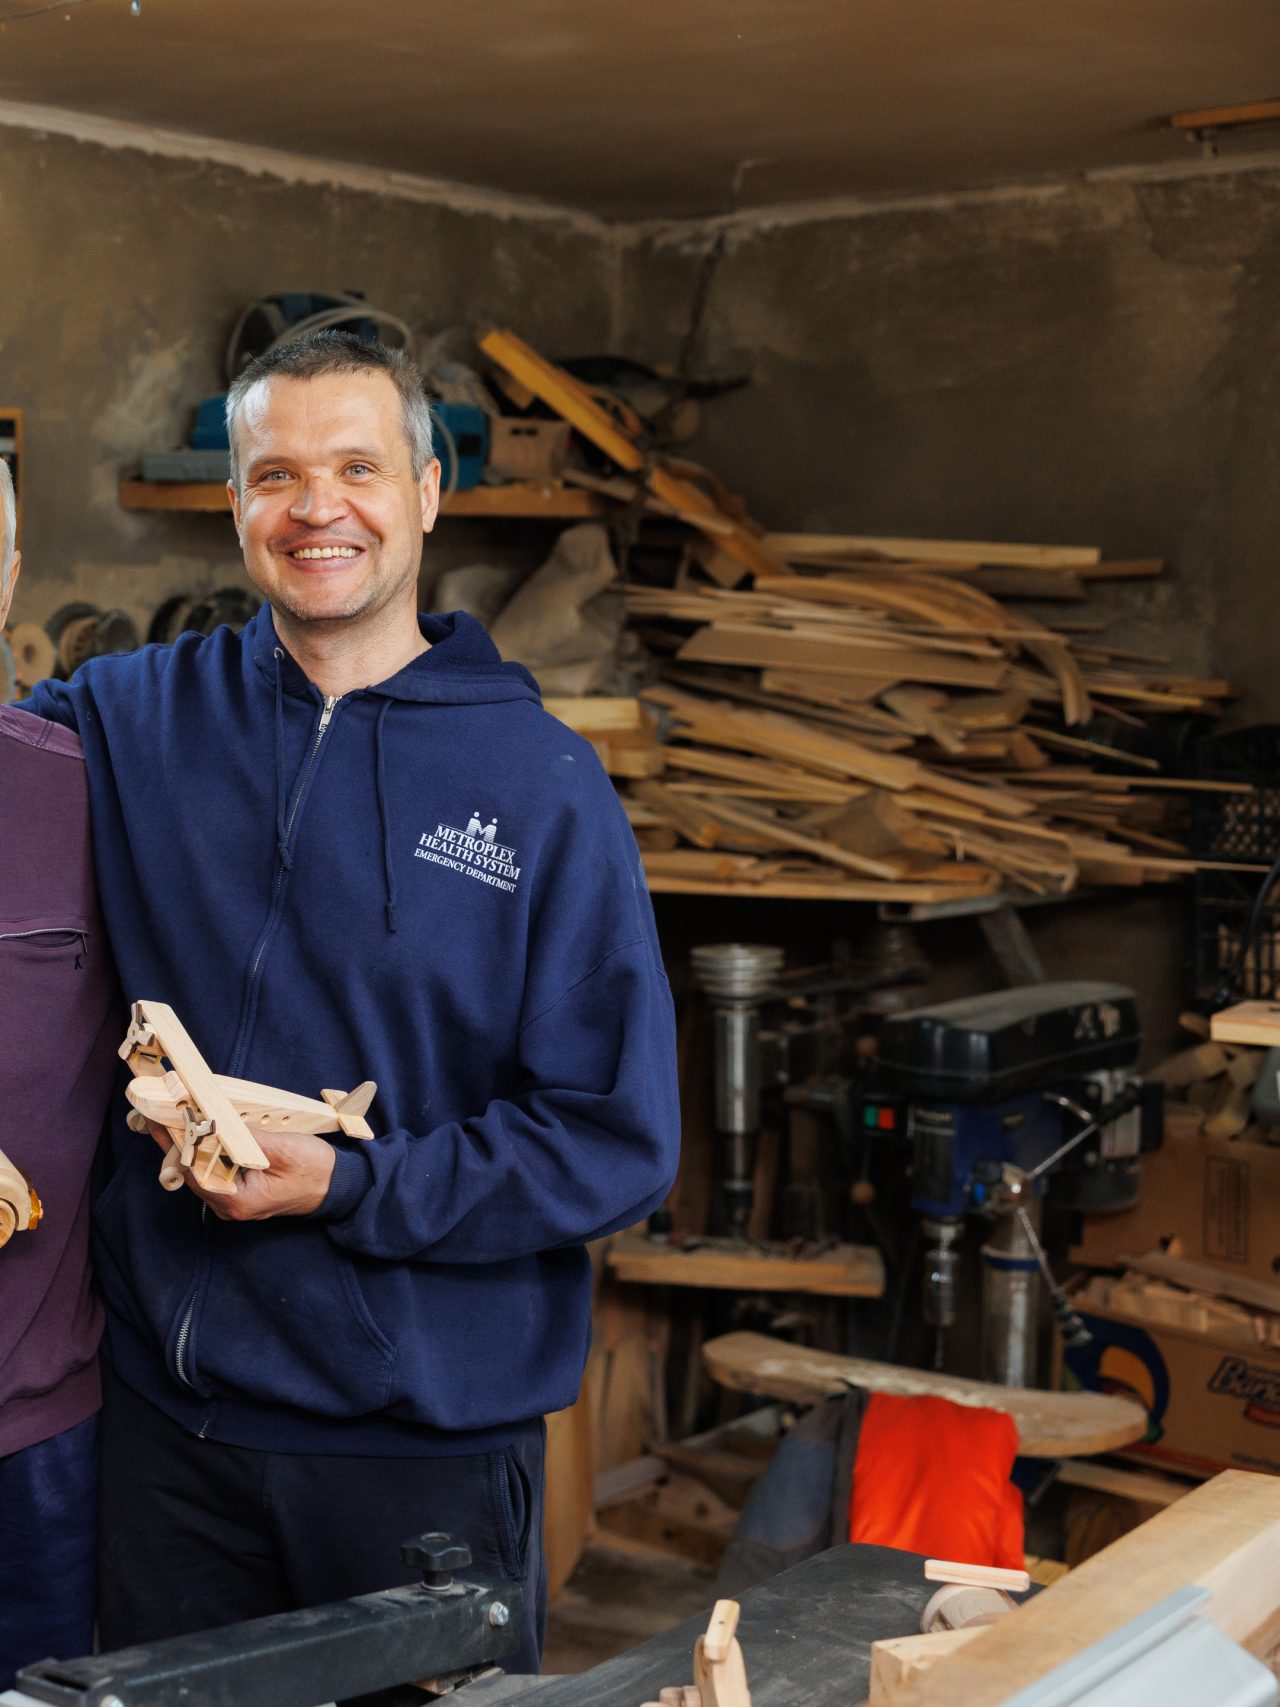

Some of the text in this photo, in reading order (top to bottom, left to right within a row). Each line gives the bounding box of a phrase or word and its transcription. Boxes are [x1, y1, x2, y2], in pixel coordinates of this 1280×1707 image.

[418, 833, 522, 880] HEALTH SYSTEM
[434, 825, 516, 864] METROPLEX
[414, 848, 517, 893] EMERGENCY DEPARTMENT
